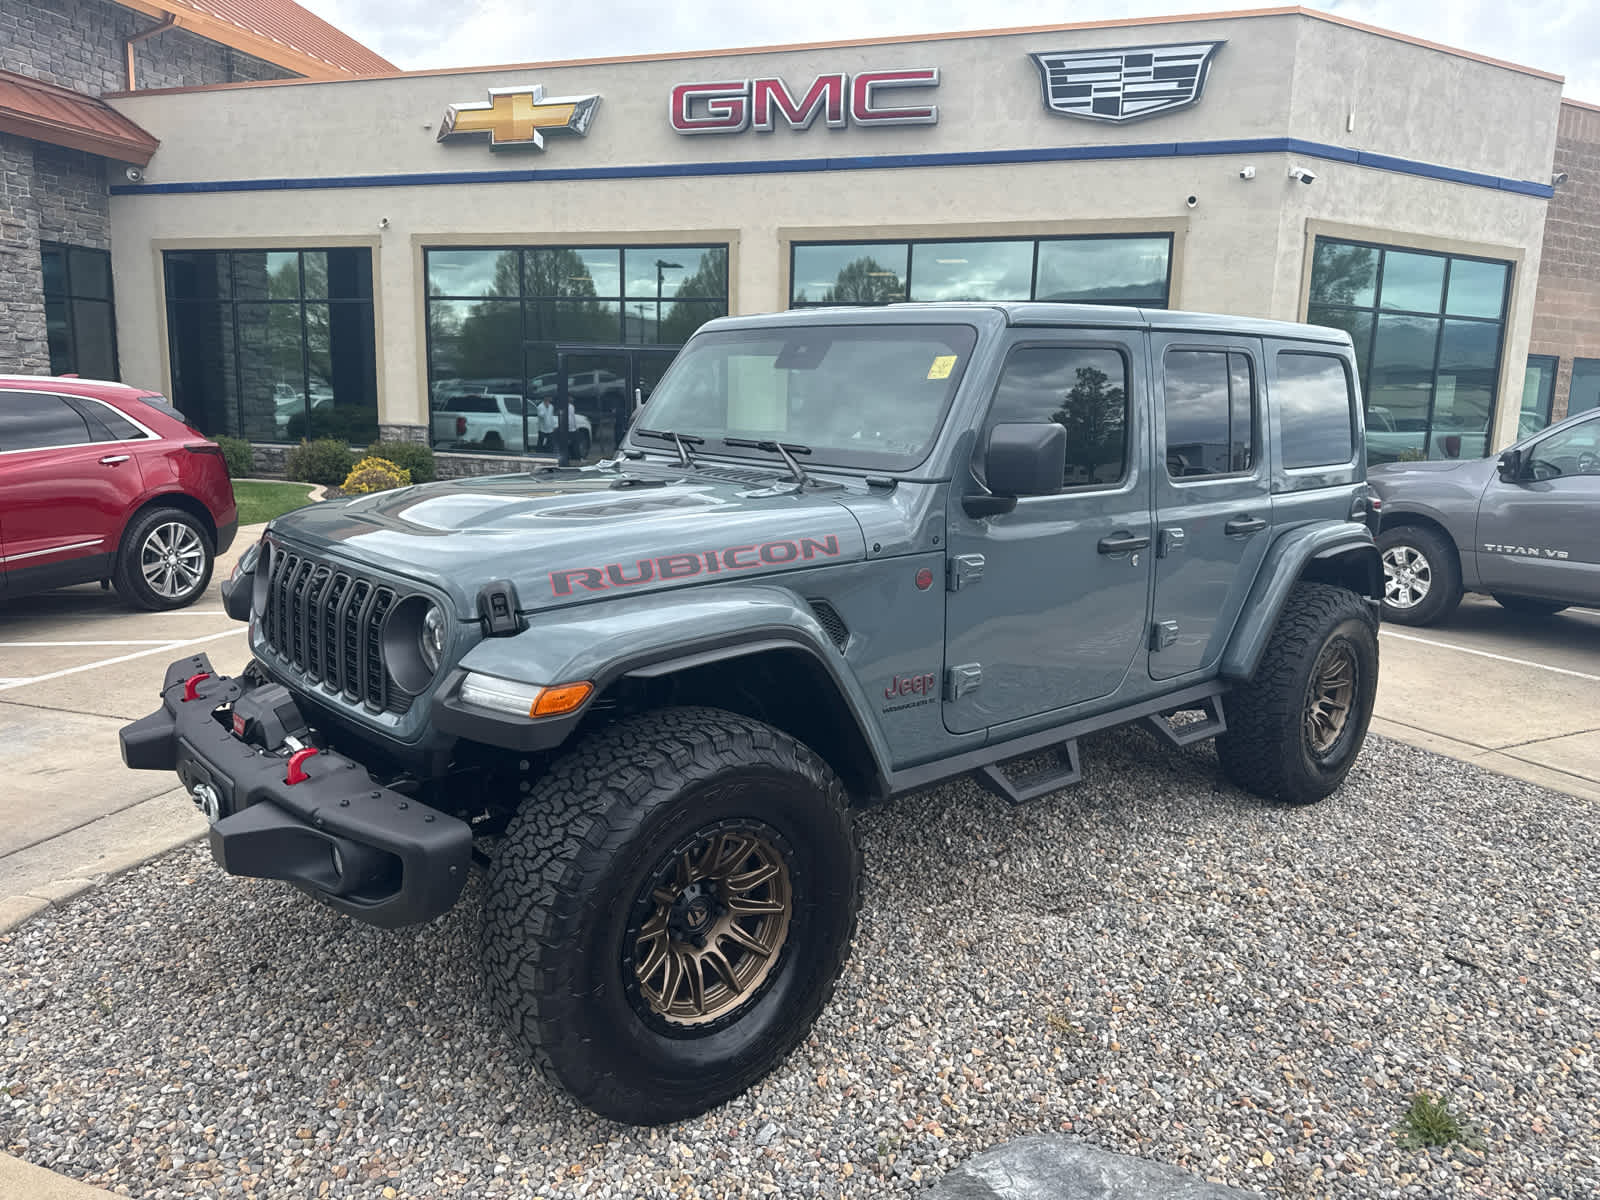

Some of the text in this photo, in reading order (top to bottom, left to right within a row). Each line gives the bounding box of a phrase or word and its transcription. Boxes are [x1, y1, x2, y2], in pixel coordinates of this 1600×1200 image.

[669, 66, 939, 134] GMC
[549, 535, 840, 597] RUBICON
[1484, 543, 1540, 556] TITAN
[885, 673, 935, 700] Jeep
